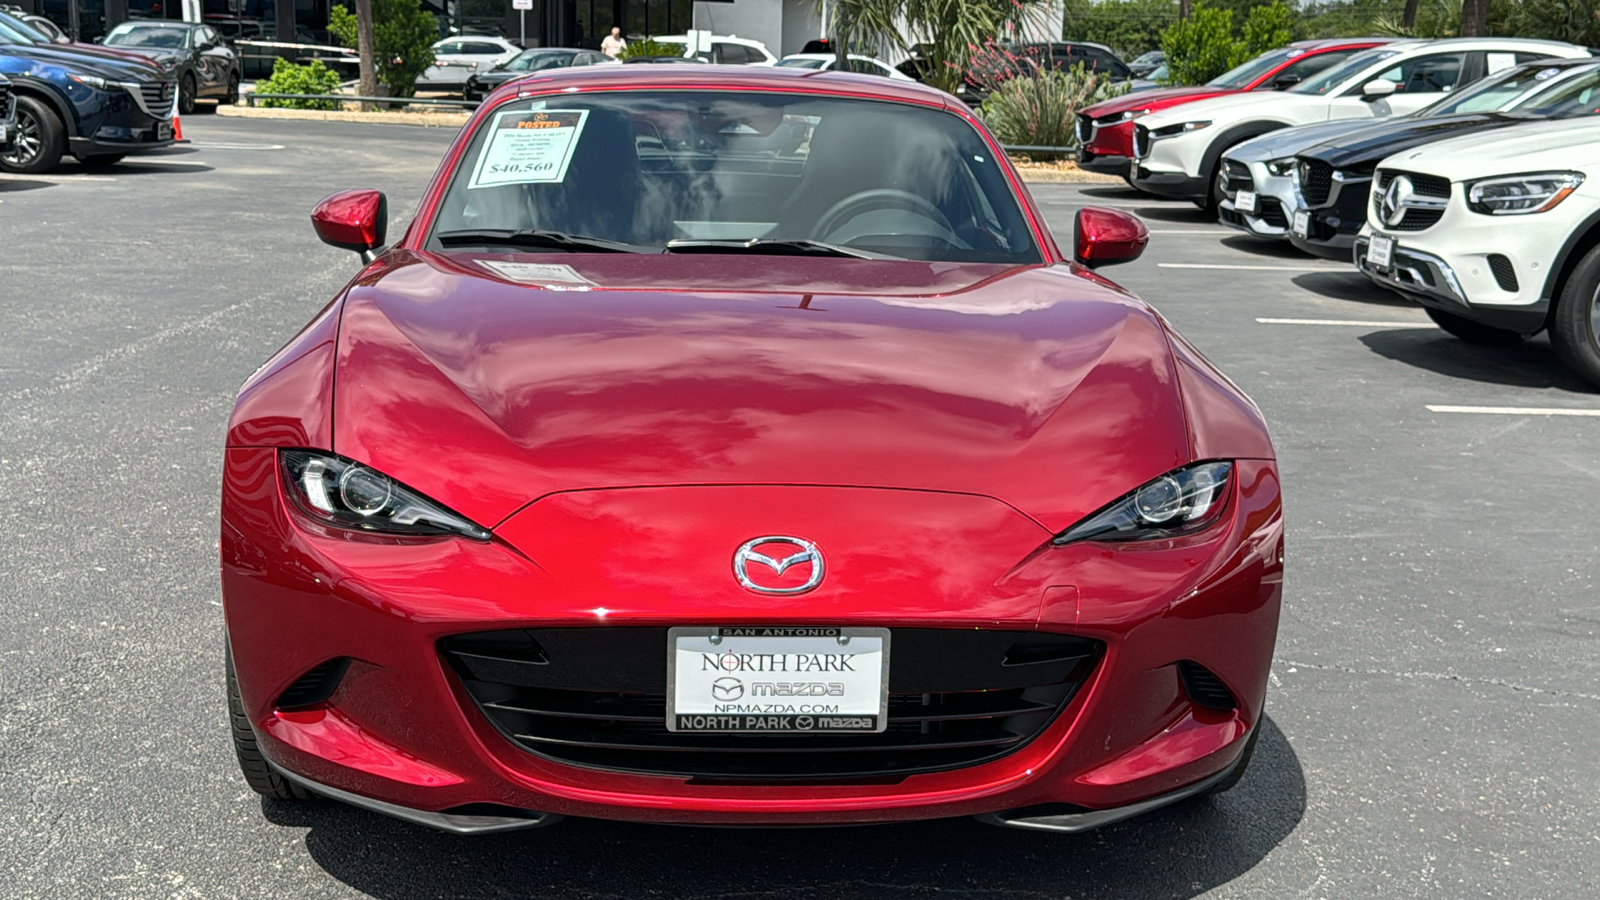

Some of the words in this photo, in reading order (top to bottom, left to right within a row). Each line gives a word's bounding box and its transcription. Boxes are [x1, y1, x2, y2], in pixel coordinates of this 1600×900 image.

[517, 121, 560, 129] POSTED
[722, 628, 756, 636] SAN
[762, 628, 837, 636] ANTONIO
[701, 653, 787, 672] NORTH
[795, 653, 856, 672] PARK
[751, 682, 845, 696] mazda
[714, 704, 838, 713] NPMAZDA.COM
[680, 716, 740, 729] NORTH
[745, 716, 791, 729] PARK
[819, 717, 872, 728] mazda
